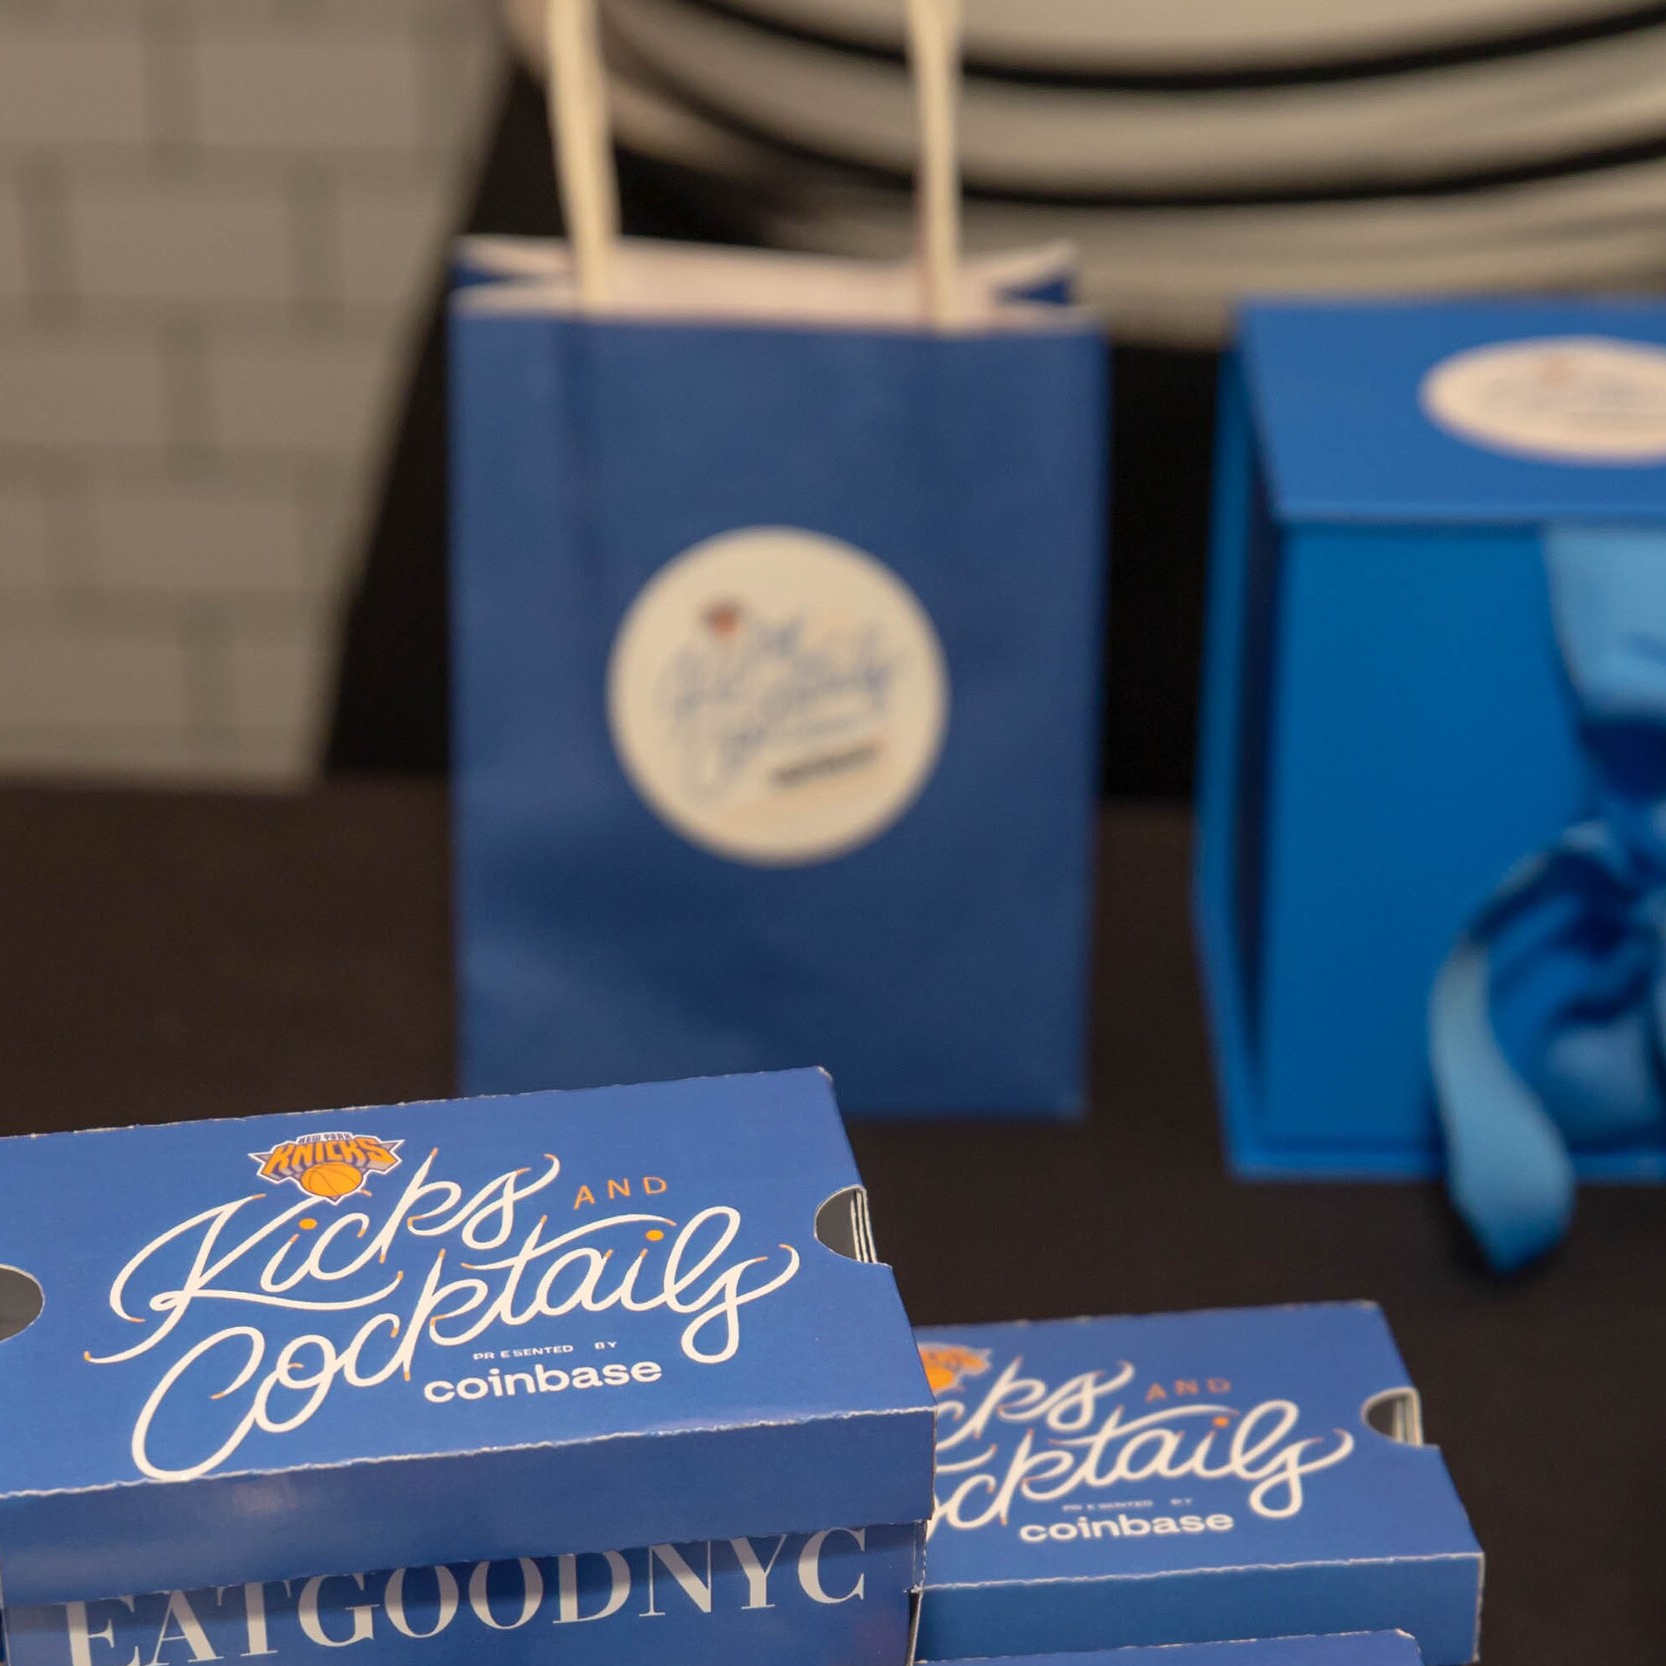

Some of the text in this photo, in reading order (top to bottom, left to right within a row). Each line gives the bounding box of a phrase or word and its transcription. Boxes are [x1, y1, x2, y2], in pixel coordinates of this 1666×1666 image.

[261, 1137, 398, 1177] KNICKS
[83, 1147, 669, 1363] Kicks AND
[130, 1205, 801, 1482] Cocktails
[594, 1341, 618, 1351] BY
[424, 1361, 663, 1403] coinbase
[1145, 1378, 1232, 1403] AND
[927, 1399, 1354, 1542] cktails
[1019, 1513, 1235, 1543] coinbase
